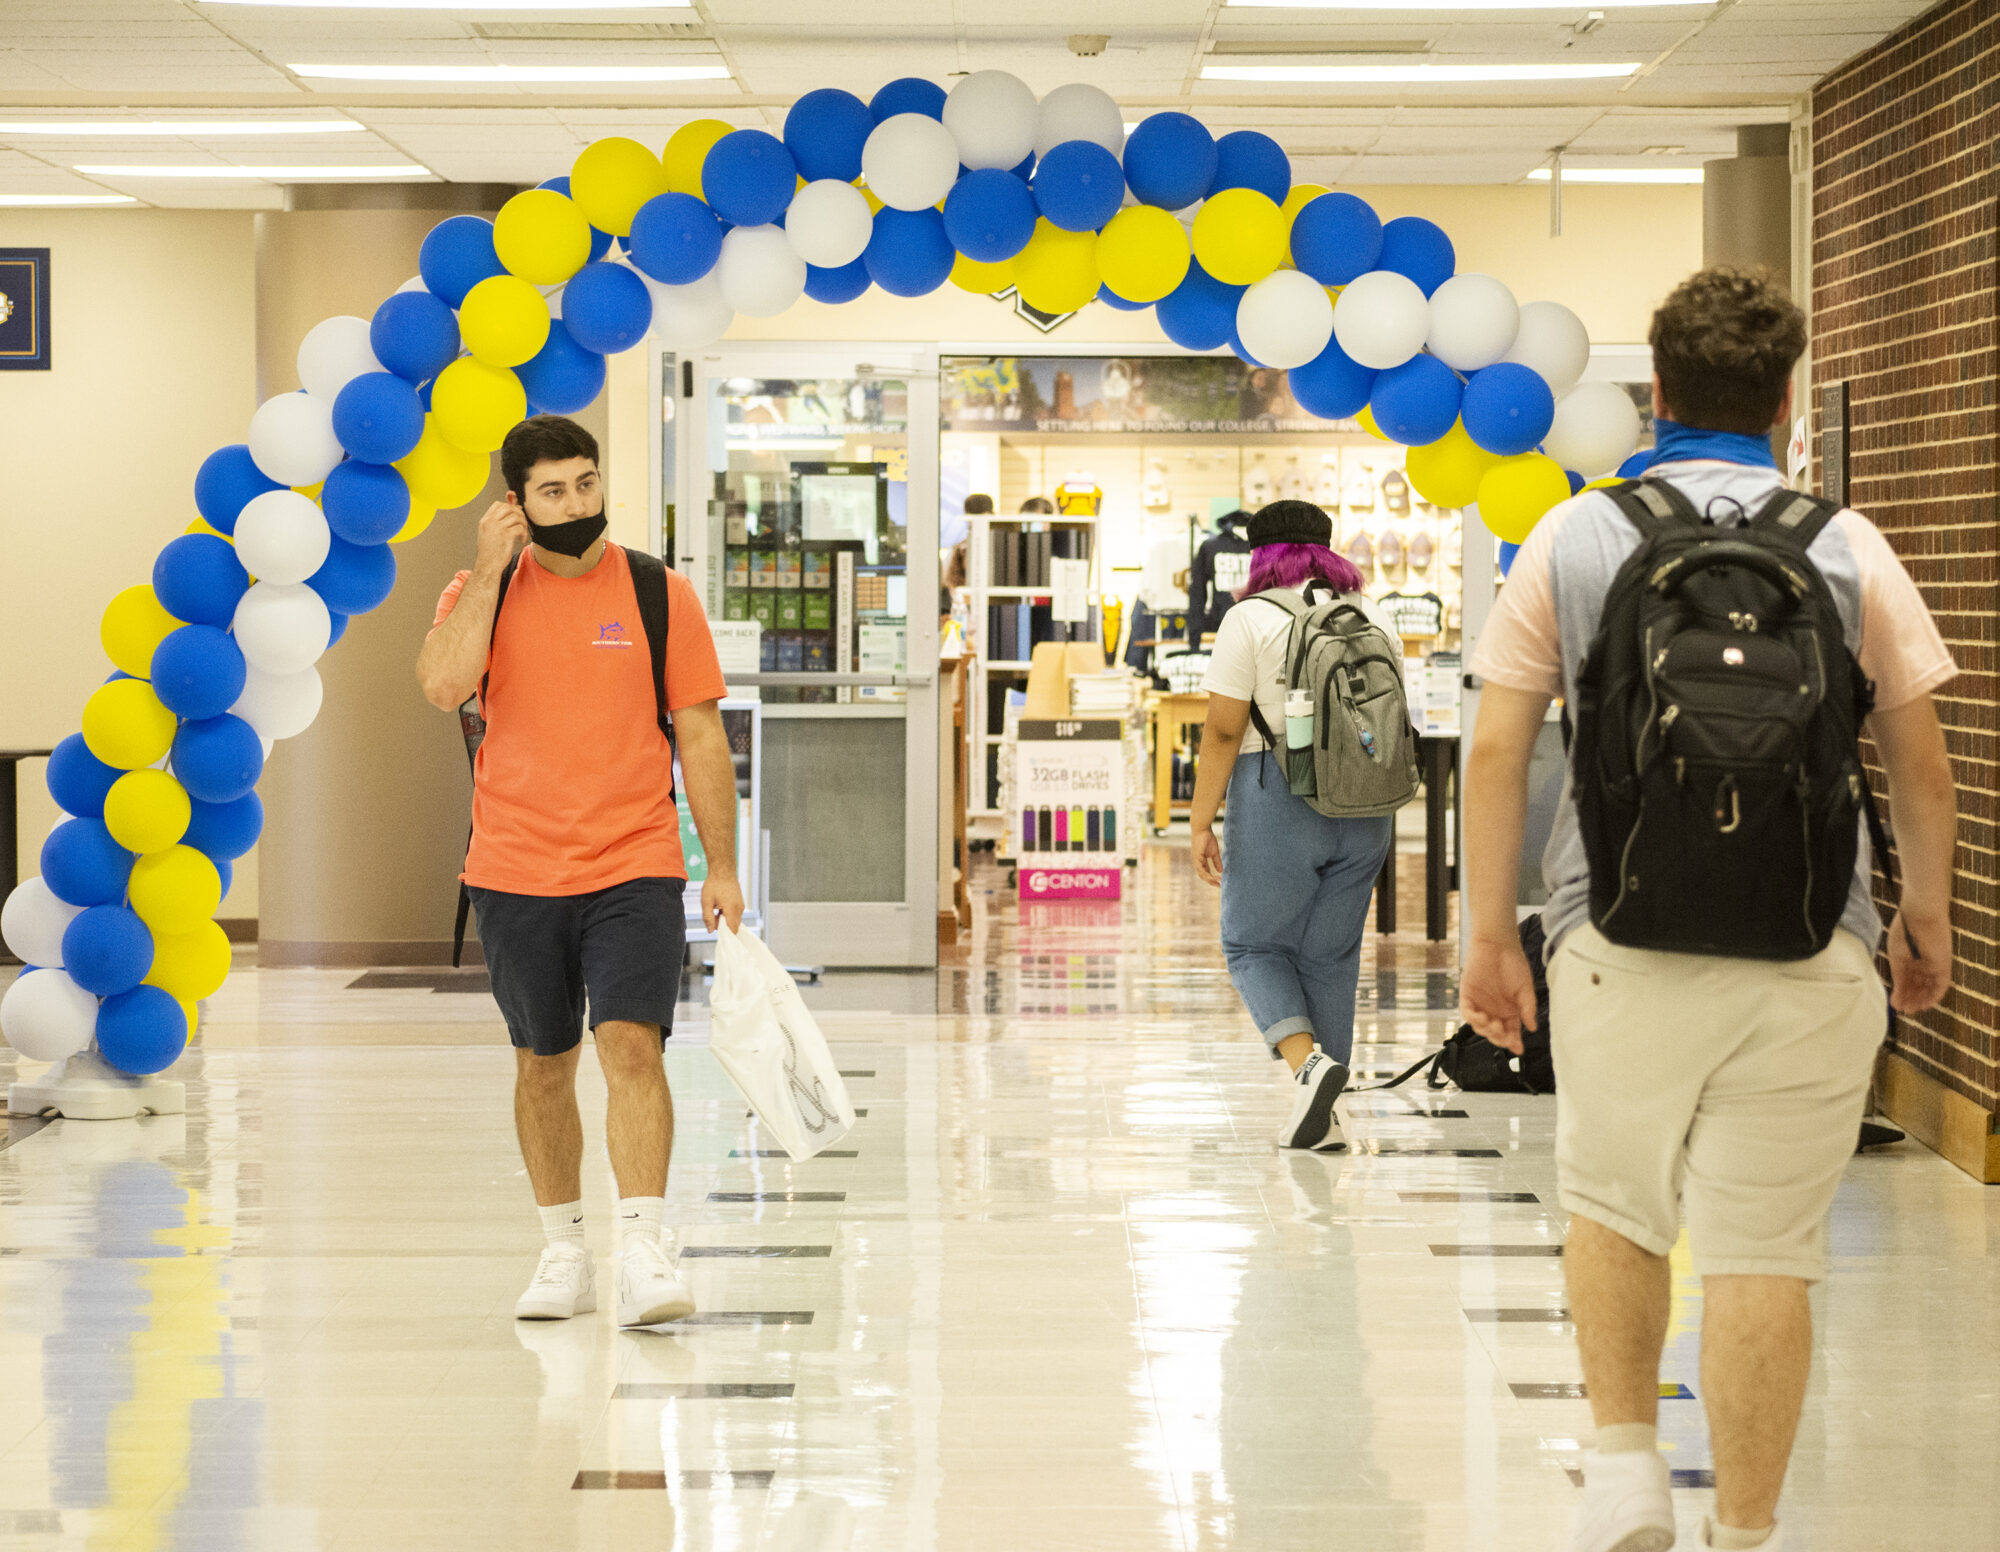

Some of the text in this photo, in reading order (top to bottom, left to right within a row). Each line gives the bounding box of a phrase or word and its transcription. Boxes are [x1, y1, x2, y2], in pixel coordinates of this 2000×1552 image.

[1031, 767, 1110, 782] 32GB FLASH
[1071, 781, 1110, 791] DRIVES
[1048, 873, 1110, 890] CENTON
